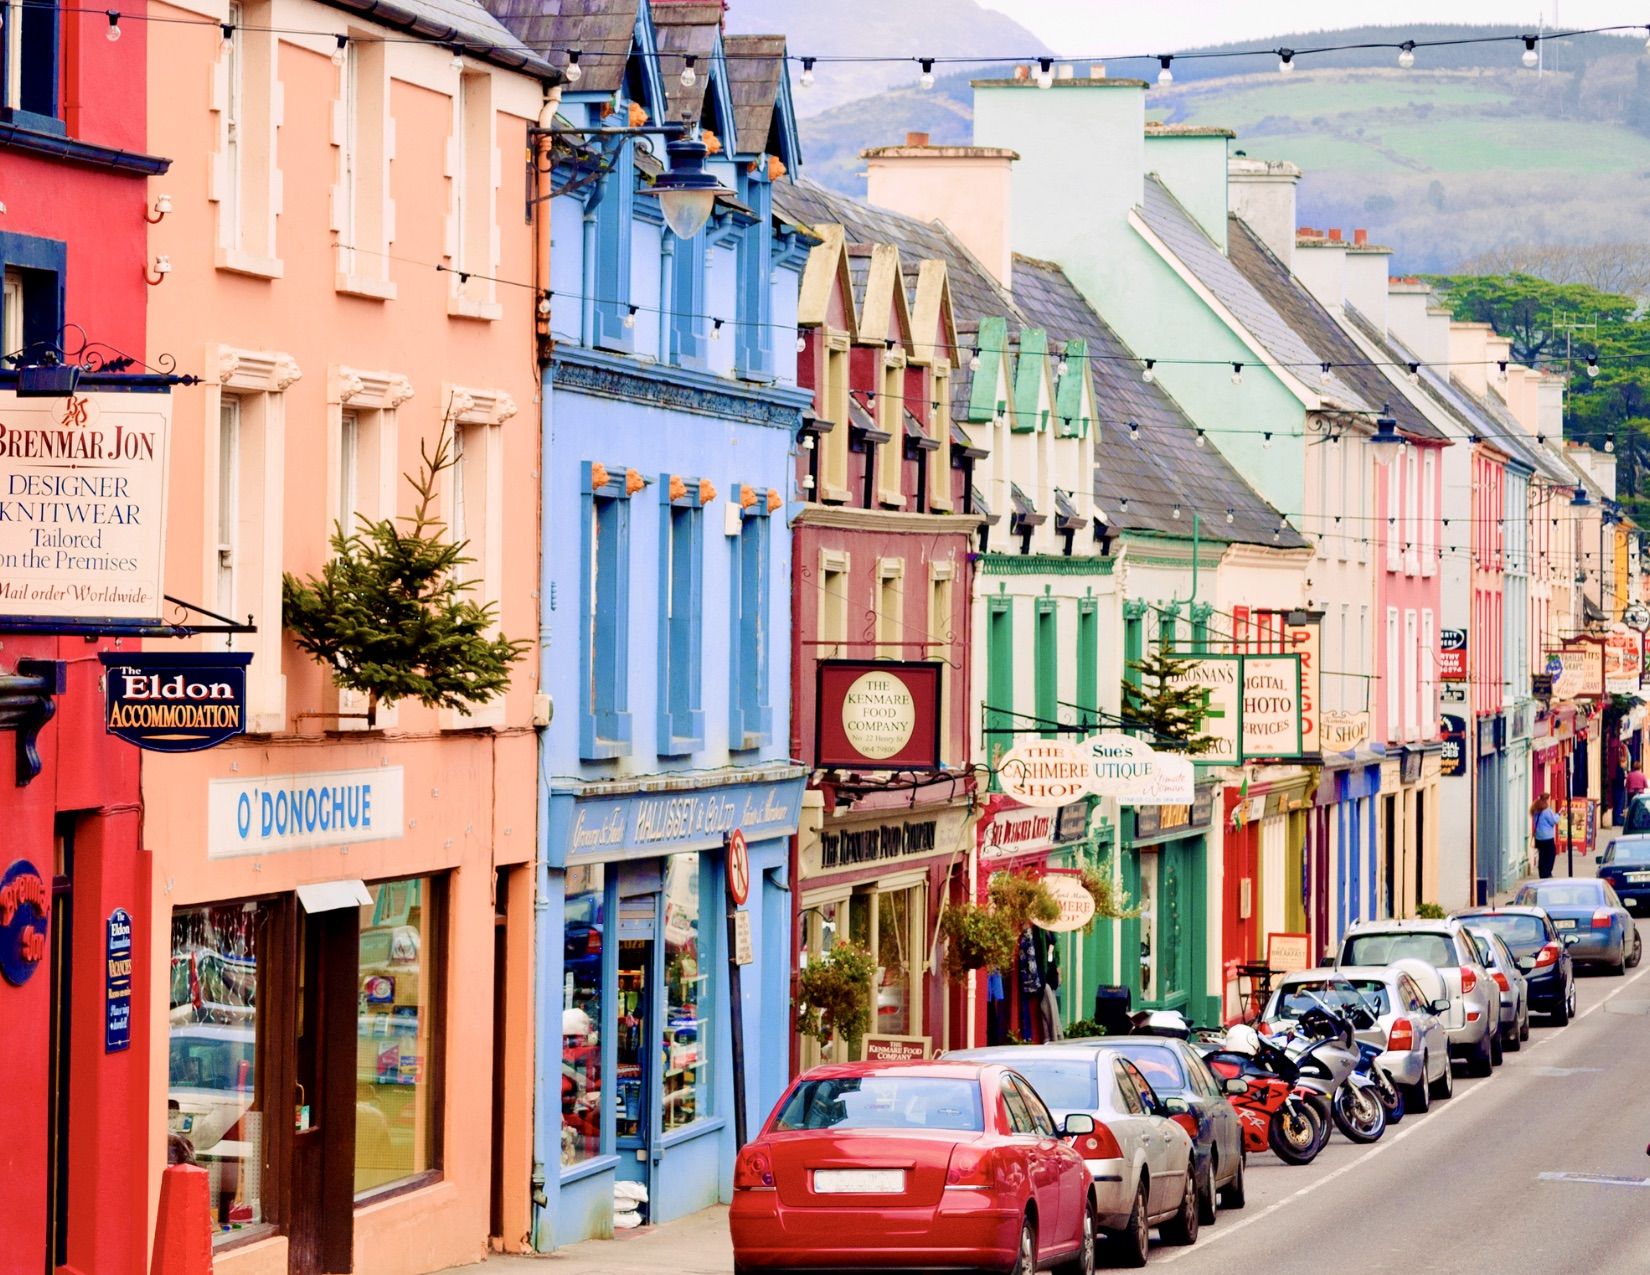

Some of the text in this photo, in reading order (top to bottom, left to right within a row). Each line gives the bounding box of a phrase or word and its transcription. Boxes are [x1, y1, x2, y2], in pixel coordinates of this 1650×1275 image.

[0, 422, 156, 461] BRENMAR JON
[9, 474, 130, 498] DESIGNER
[0, 501, 141, 525] KNITWEAR
[31, 528, 102, 549] Tailored
[22, 548, 51, 568] the
[56, 550, 138, 571] Premises
[0, 582, 149, 604] Mail order Worldwide
[120, 666, 141, 675] The
[122, 674, 235, 700] Eldon
[866, 681, 890, 691] THE
[848, 693, 909, 705] KENMARE
[1243, 697, 1291, 713] HOTO
[109, 700, 240, 728] ACCOMMODATION
[863, 707, 896, 718] FOOD
[848, 720, 909, 732] COMPANY
[1243, 719, 1290, 735] ERVICES
[1336, 721, 1367, 742] SHOP
[1024, 748, 1064, 758] THE
[1092, 743, 1133, 758] Sue's
[1002, 763, 1089, 779] CASHMERE
[1095, 762, 1153, 780] UTIQUE
[1013, 784, 1082, 797] SHOP
[821, 831, 839, 868] THE
[1059, 901, 1091, 913] MERE
[869, 1045, 922, 1055] KENMARE FOOD
